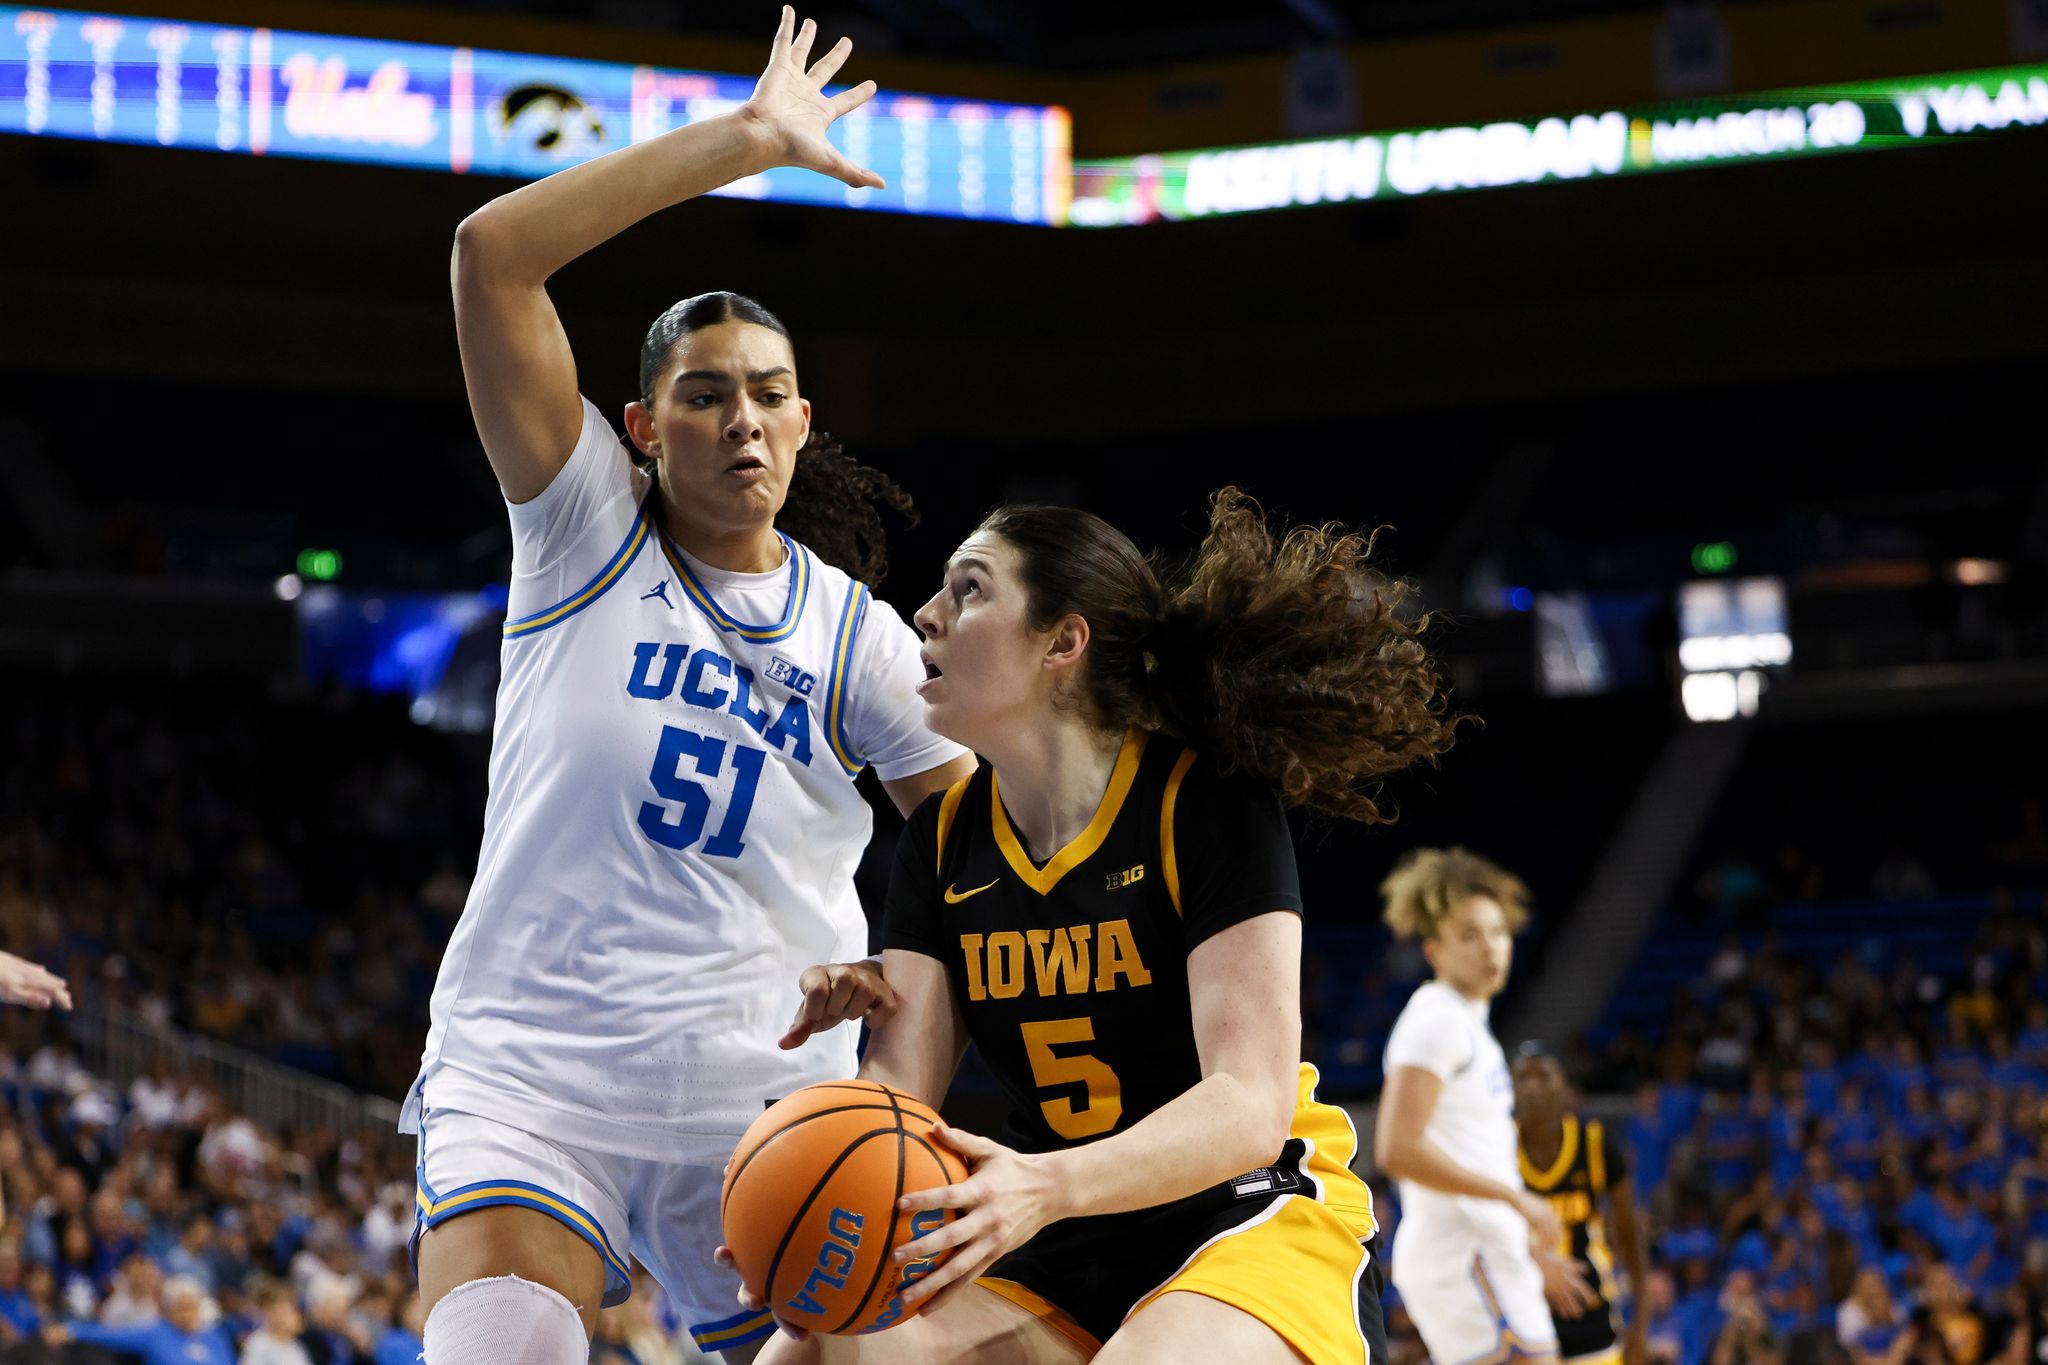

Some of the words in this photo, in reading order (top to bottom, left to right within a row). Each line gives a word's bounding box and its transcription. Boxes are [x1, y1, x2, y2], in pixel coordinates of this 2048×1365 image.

[626, 642, 814, 767] UCLA
[637, 724, 767, 859] 51
[960, 918, 1153, 1001] IOWA
[1020, 1016, 1123, 1140] 5
[1276, 1171, 1288, 1182] L
[786, 1206, 865, 1316] UCLA
